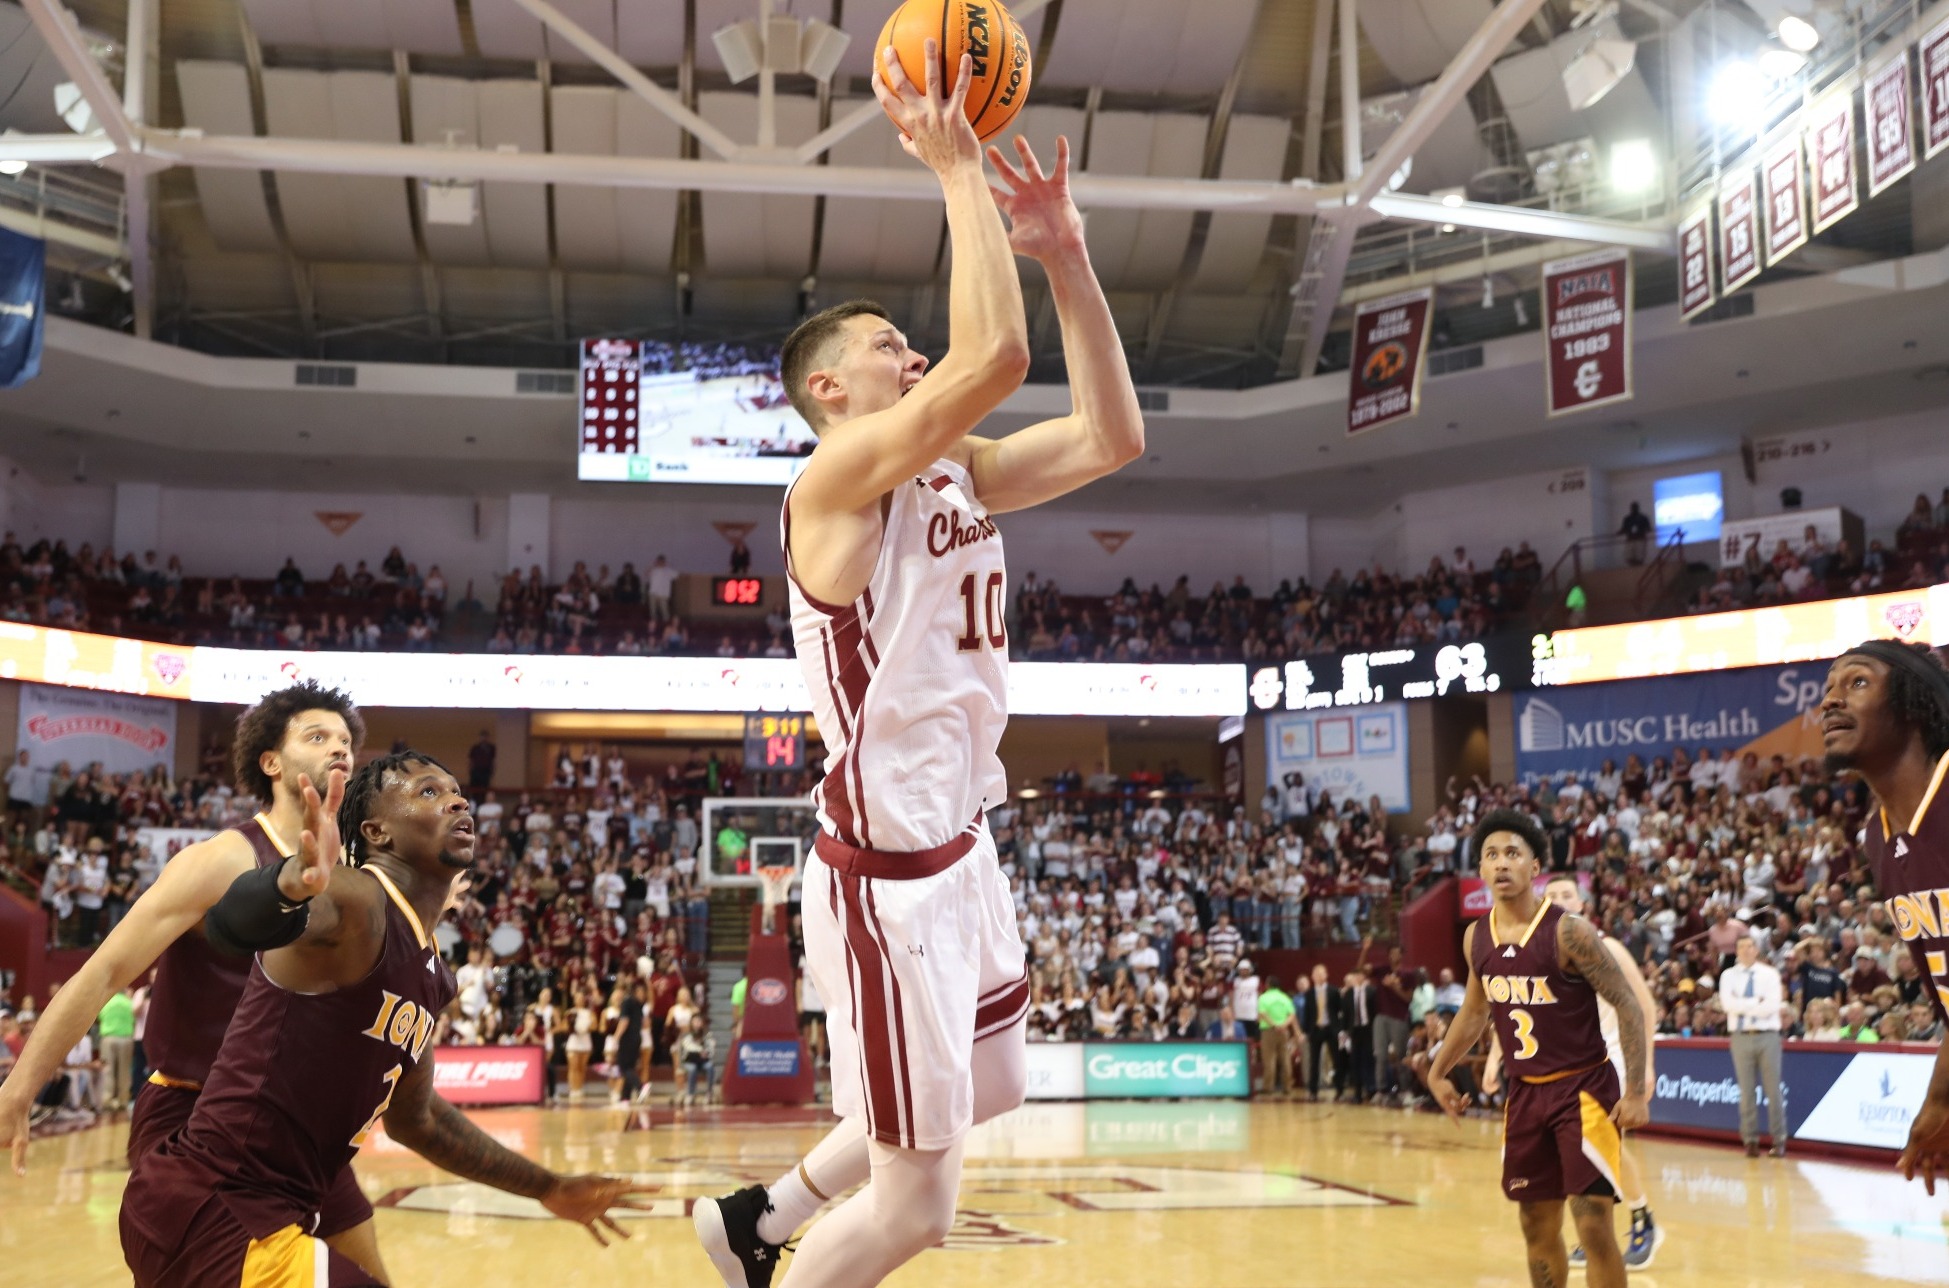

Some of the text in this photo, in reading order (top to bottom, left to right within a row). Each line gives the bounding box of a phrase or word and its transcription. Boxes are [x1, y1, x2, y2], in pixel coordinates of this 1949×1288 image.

[966, 2, 989, 78] NCAA
[1558, 269, 1616, 305] NAIA
[1551, 310, 1623, 340] CHAMPIONS
[1556, 296, 1617, 324] NATIONAL
[1564, 332, 1611, 360] 1983
[957, 570, 1006, 653] 10
[1566, 706, 1760, 750] MUSC Health
[767, 736, 794, 767] 14
[1481, 974, 1559, 1005] IONA
[361, 989, 435, 1065] ION
[1509, 1008, 1539, 1060] 3
[1088, 1053, 1237, 1086] Great Clips
[1656, 1074, 1679, 1100] Our
